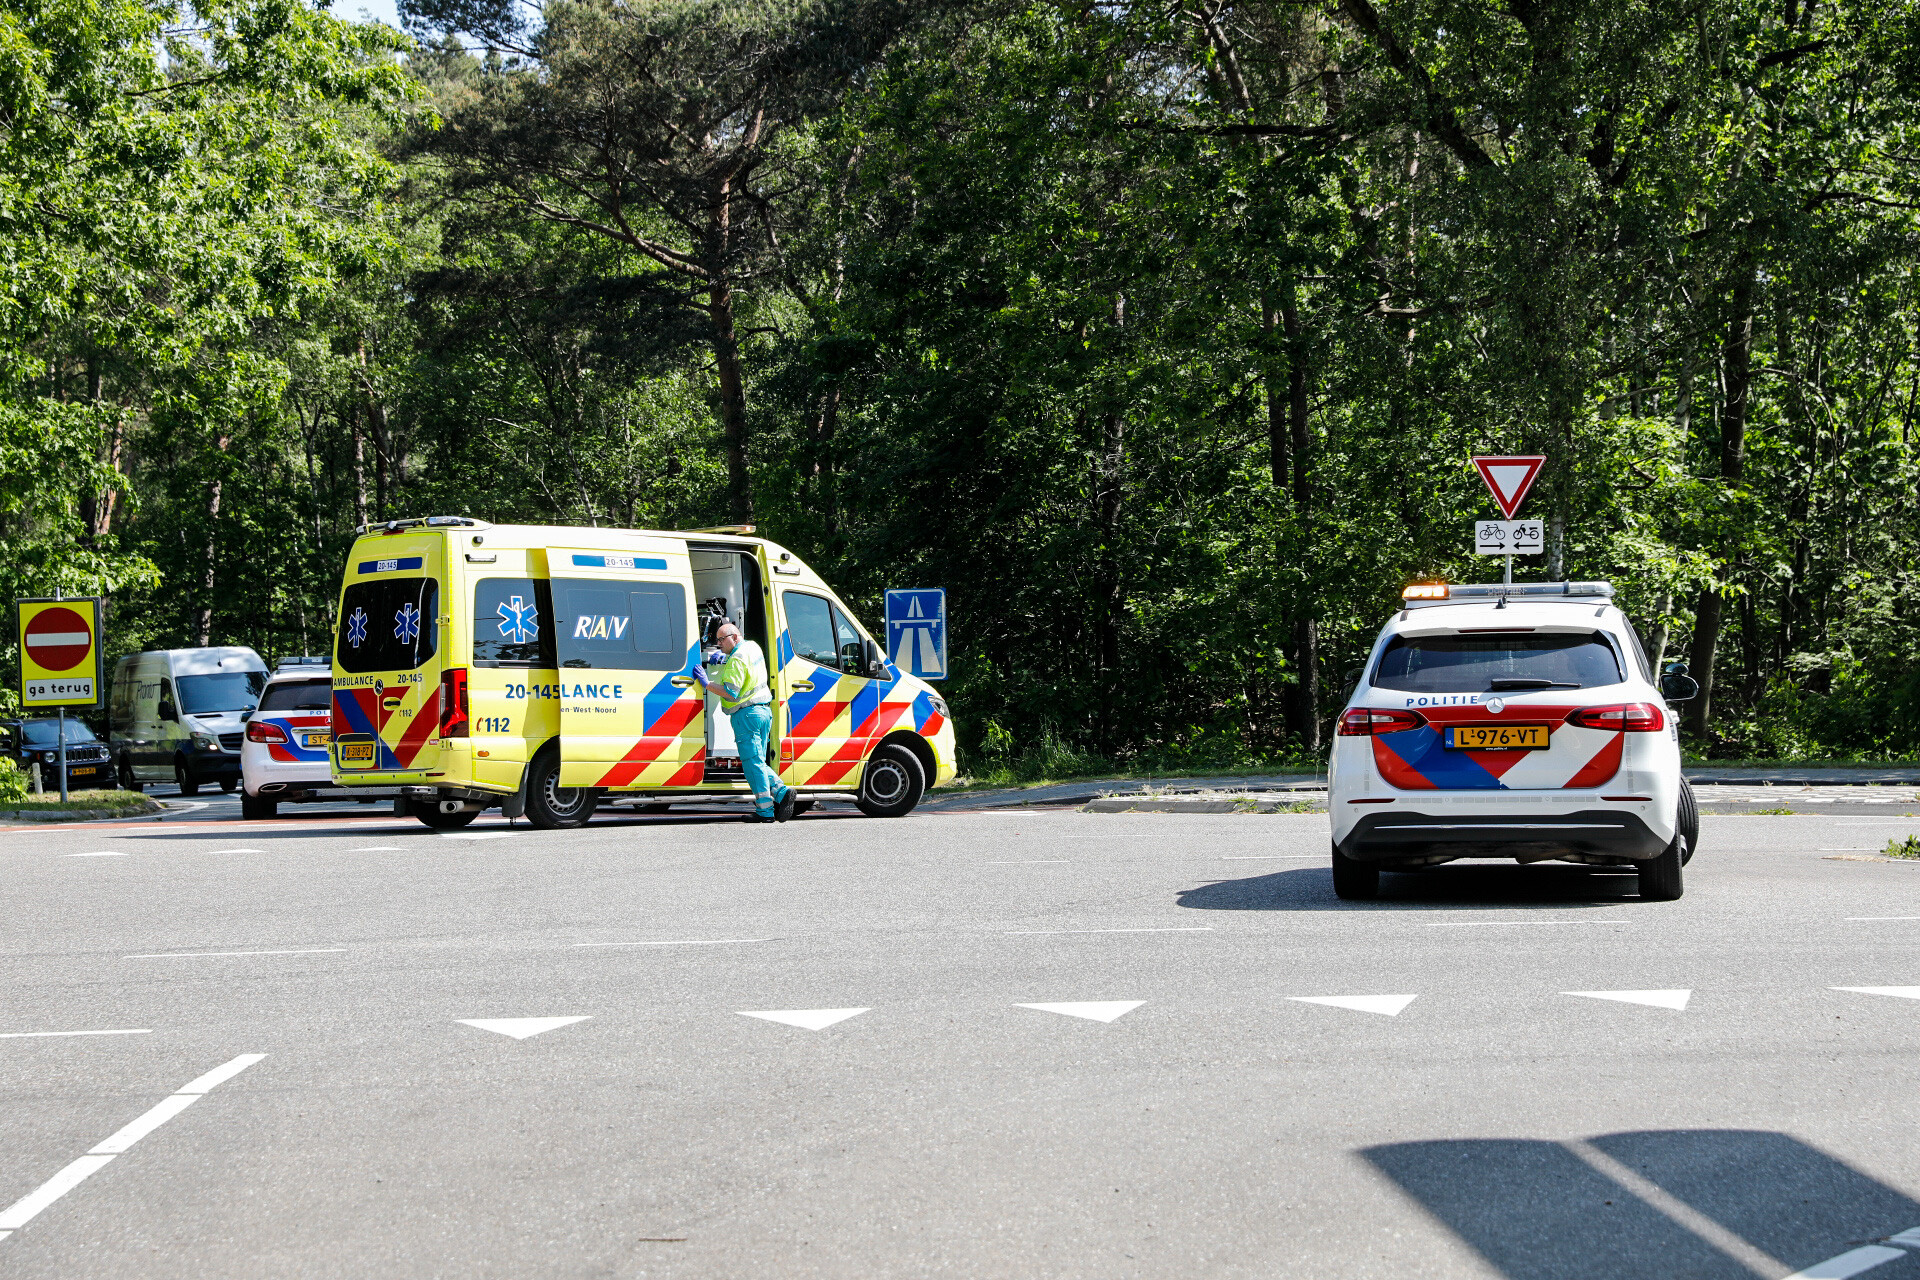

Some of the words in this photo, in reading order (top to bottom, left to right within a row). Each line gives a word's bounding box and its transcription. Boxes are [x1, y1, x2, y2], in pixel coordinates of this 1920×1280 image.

[378, 561, 397, 570] 20-145
[605, 558, 634, 566] 20-145
[333, 675, 374, 687] AMBULANCE
[397, 673, 423, 683] 20-145
[29, 686, 45, 697] ga
[51, 684, 90, 695] terug
[505, 684, 560, 700] 20-145
[561, 684, 623, 699] LANCE
[1406, 695, 1478, 707] POLITIE
